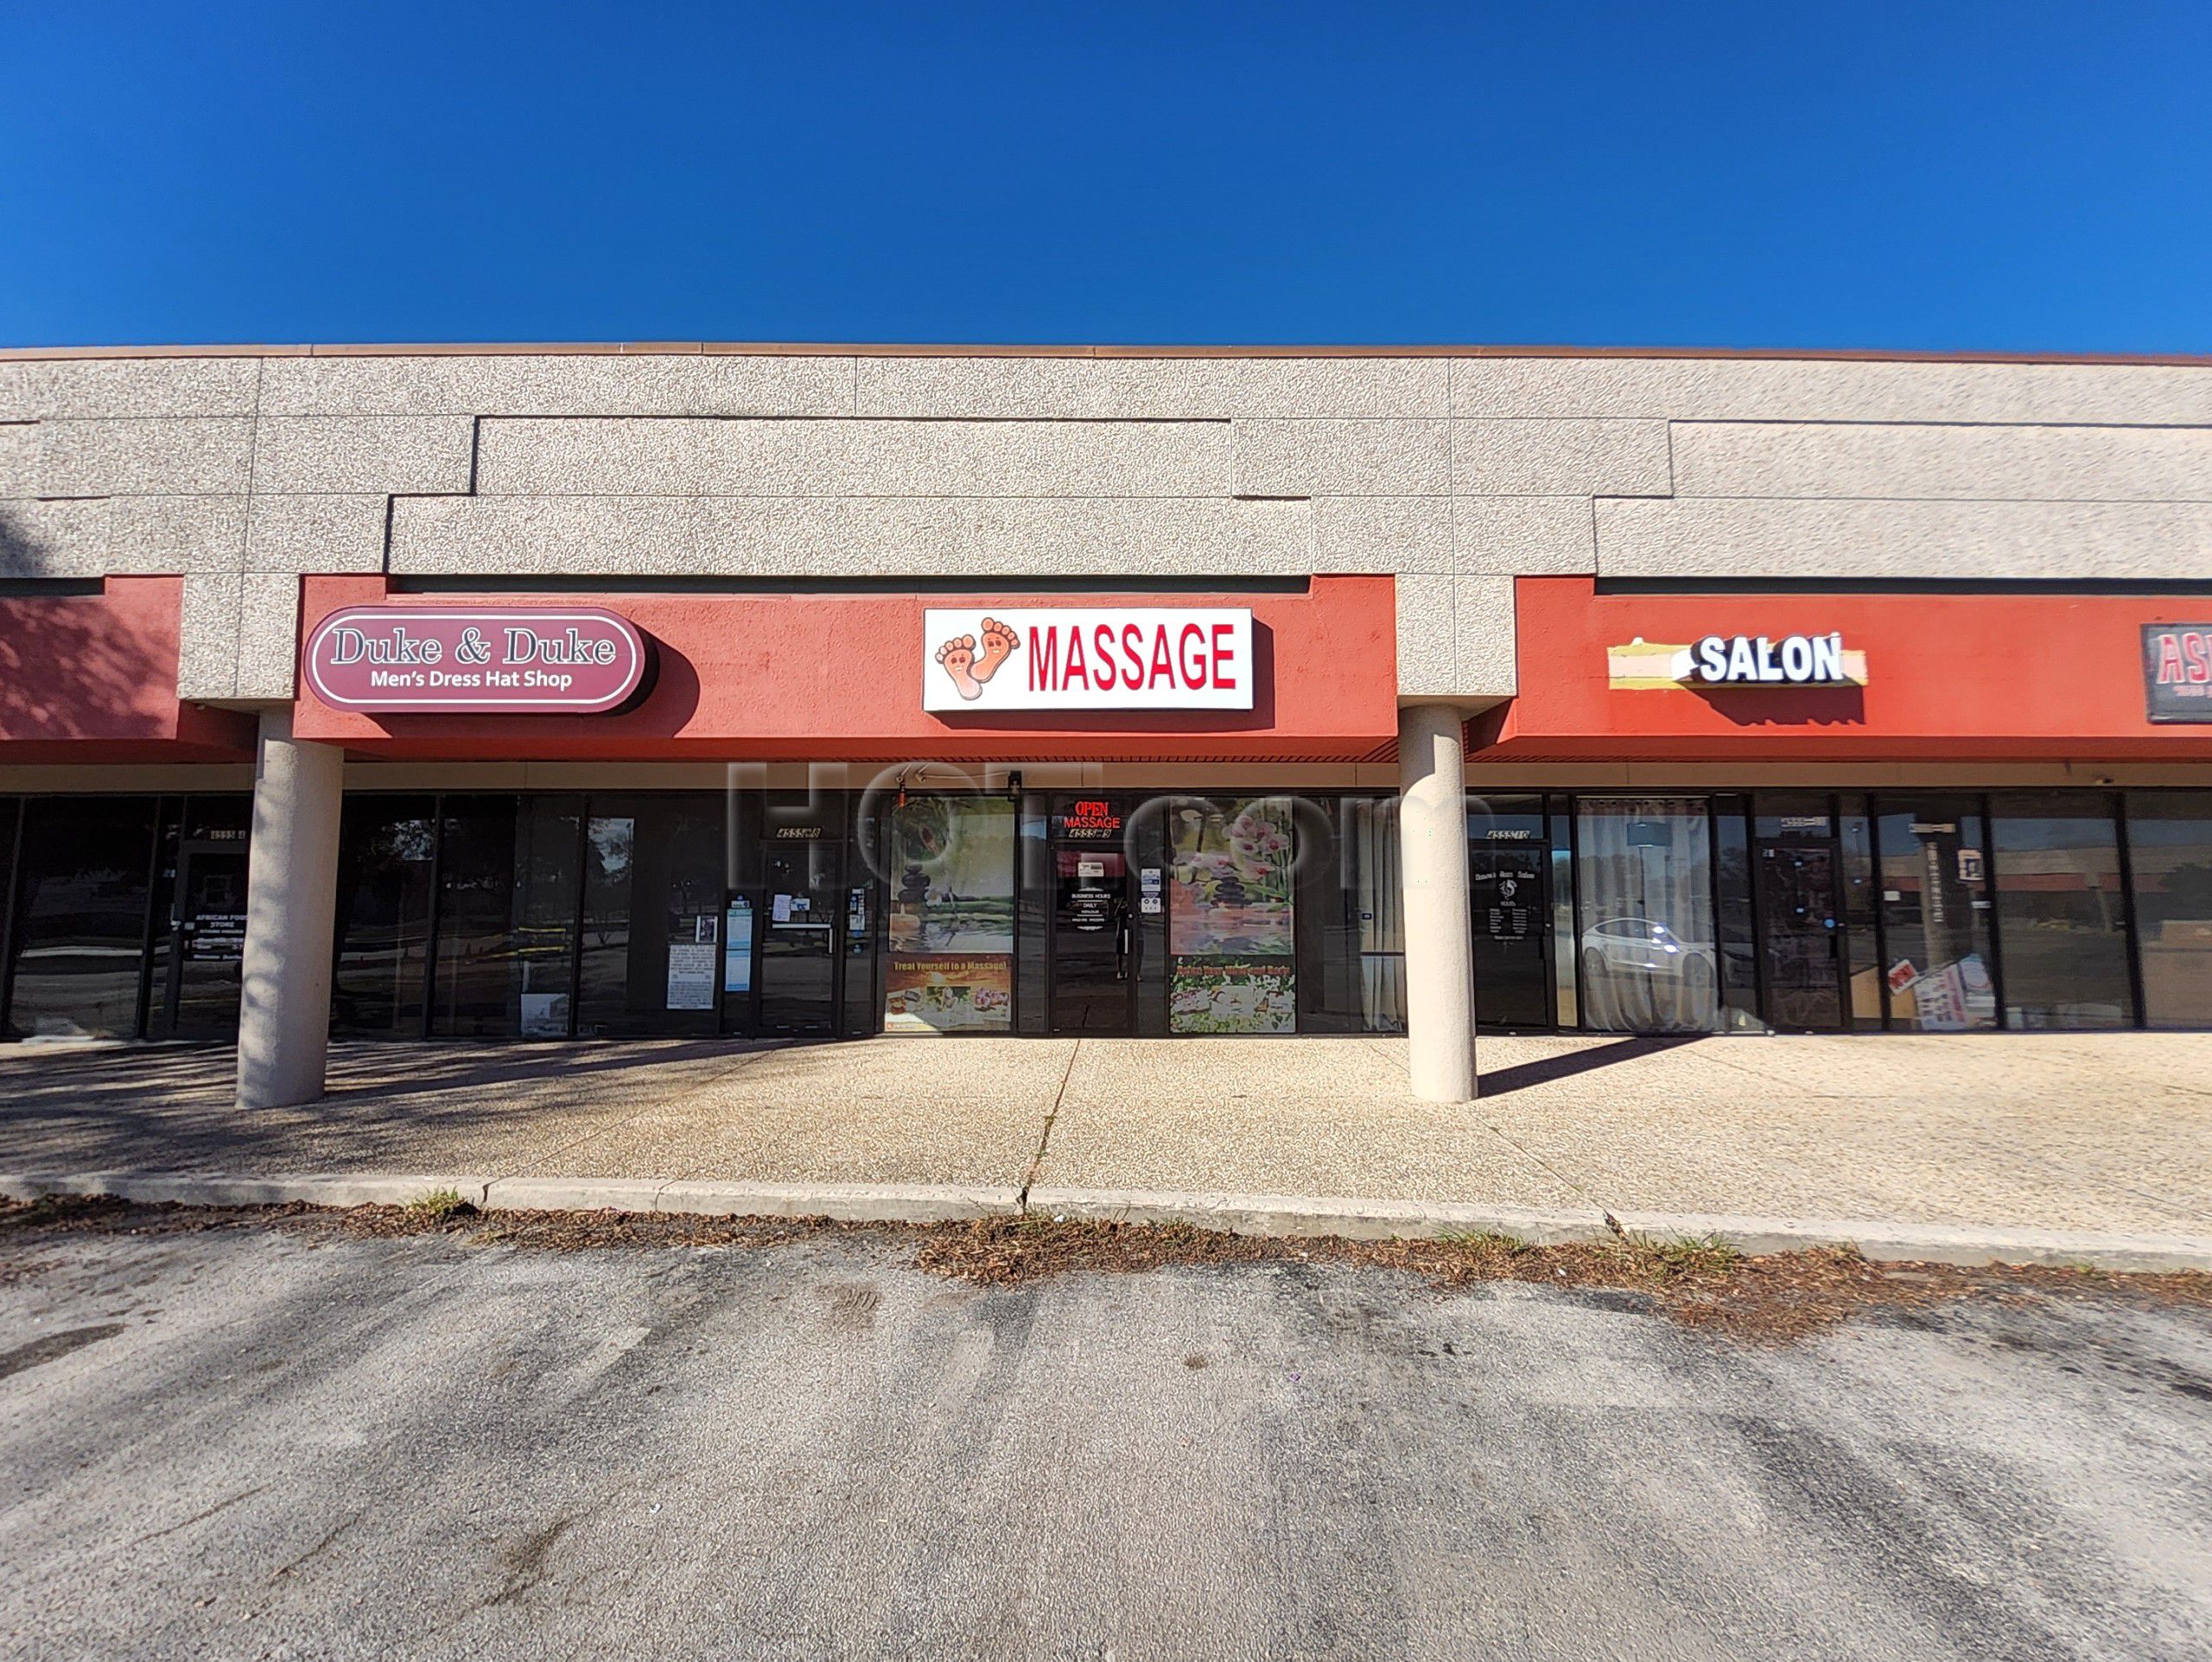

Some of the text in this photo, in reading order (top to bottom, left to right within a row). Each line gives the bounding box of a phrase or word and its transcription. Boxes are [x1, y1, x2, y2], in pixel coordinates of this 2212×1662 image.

[330, 627, 617, 665] Duke & Duke
[1028, 622, 1236, 691] MASSAGE
[1698, 633, 1844, 682] SALON
[371, 669, 573, 691] Men's Dress Hat Shop
[1075, 801, 1109, 817] OPEN
[1064, 817, 1121, 828] MASSAGE
[894, 960, 1007, 972] Treat Yourself to a Massage!
